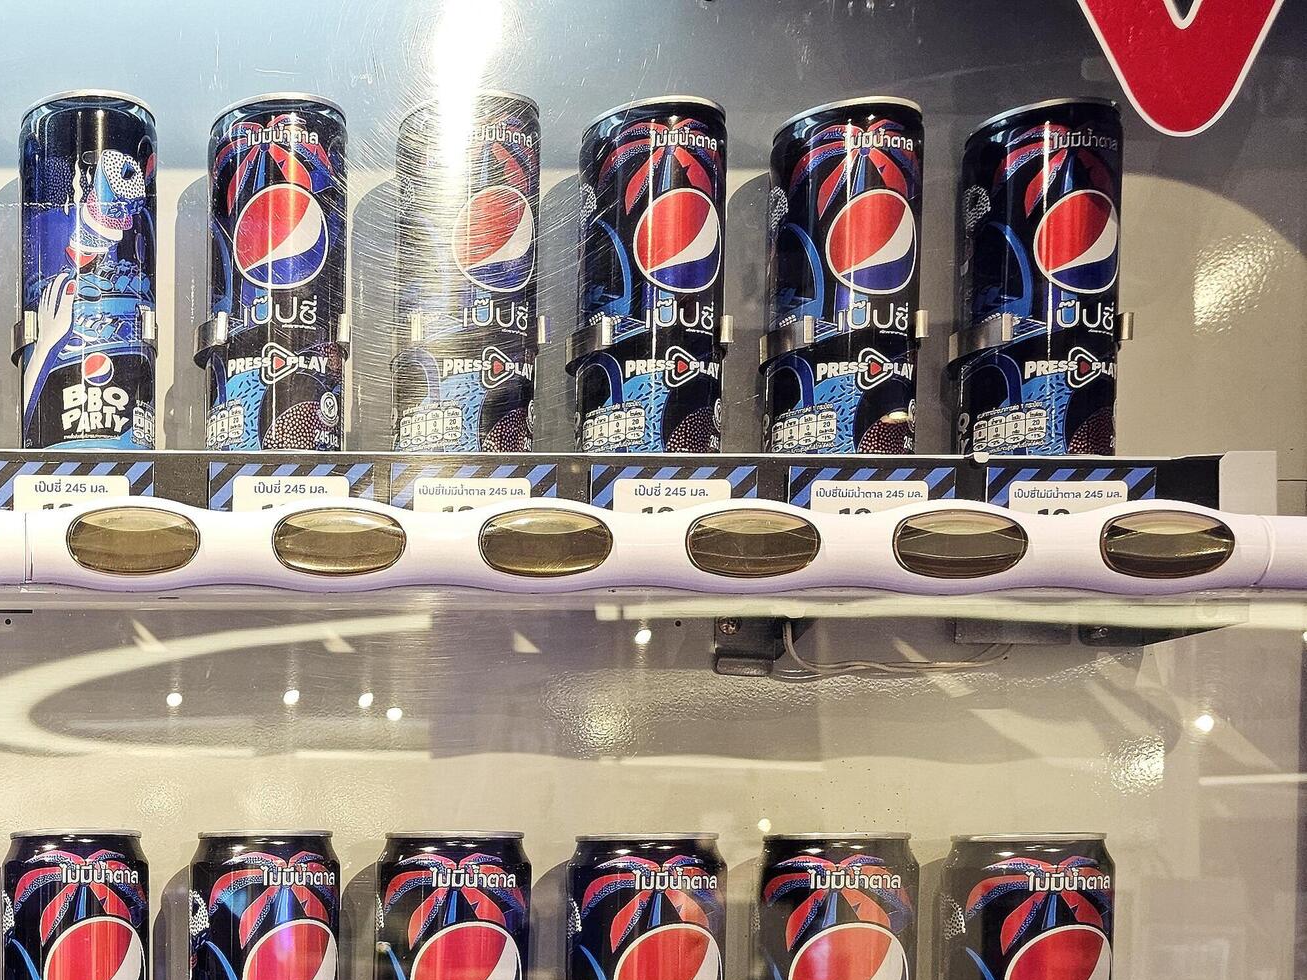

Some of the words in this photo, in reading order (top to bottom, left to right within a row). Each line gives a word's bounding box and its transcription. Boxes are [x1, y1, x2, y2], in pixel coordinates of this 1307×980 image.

[243, 295, 318, 326] เป๊ปซี่
[645, 298, 713, 329] เป๊ปซี่
[228, 357, 270, 375] PRESS
[286, 357, 328, 374] PLAY
[62, 383, 129, 412] BBQ
[61, 407, 129, 435] PARTY
[284, 484, 305, 494] 245
[885, 489, 904, 498] 245
[60, 858, 139, 885] ไม่มีน้ำตาล
[430, 862, 516, 889] ไม่มีน้ำตาล
[633, 867, 717, 891] ไม่มีน้ำตาล
[808, 865, 901, 890] ไม่มีน้ำตาล
